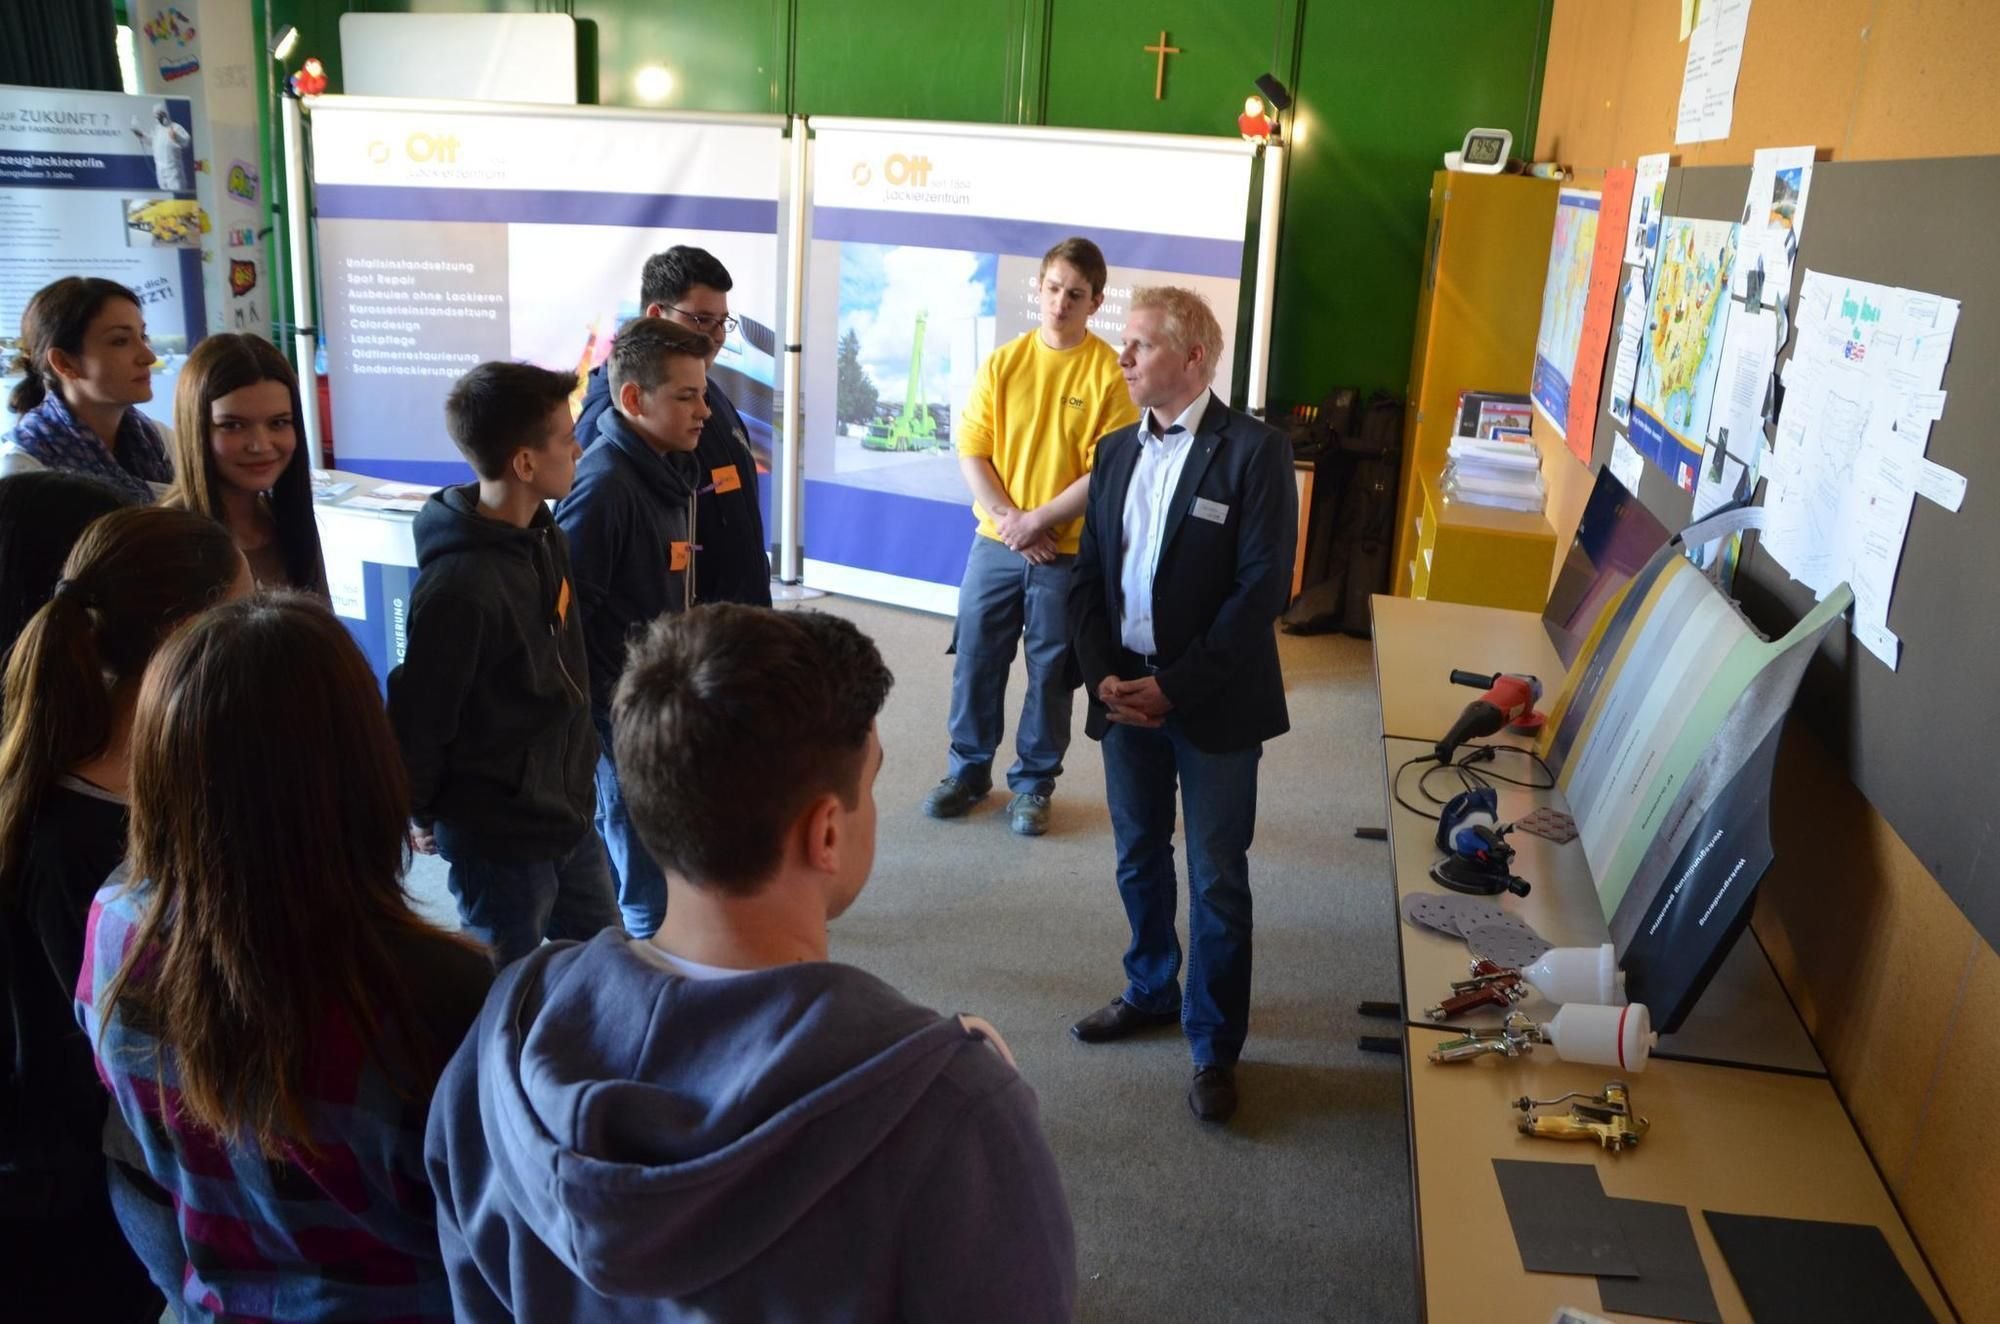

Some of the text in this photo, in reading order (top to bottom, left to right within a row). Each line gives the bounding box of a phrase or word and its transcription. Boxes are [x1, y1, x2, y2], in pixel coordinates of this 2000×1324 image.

[18, 108, 98, 125] ZUKUNFT
[405, 131, 461, 164] Ott
[883, 153, 933, 188] Ott
[346, 273, 416, 286] Spot Repair
[347, 289, 504, 303] Ausbeulen ohne Lackieren
[350, 319, 421, 332] Colordesign
[351, 334, 417, 347] Lackpflege
[393, 598, 406, 664] ACKIERUNG
[1674, 828, 1724, 894] Werksgrundierung
[1698, 857, 1746, 927] Werksgrundierung
[1649, 893, 1675, 936] geschliffen
